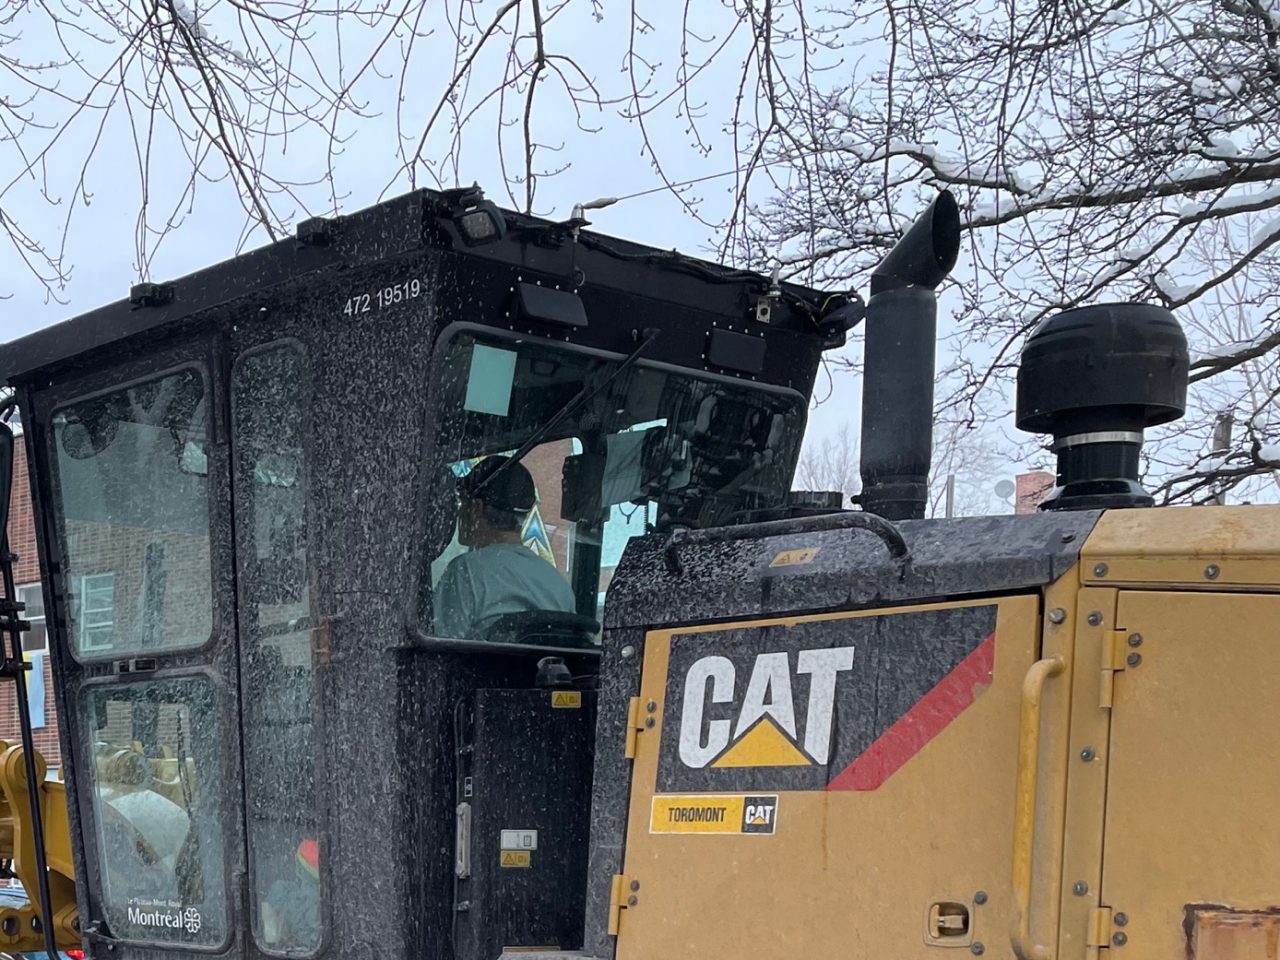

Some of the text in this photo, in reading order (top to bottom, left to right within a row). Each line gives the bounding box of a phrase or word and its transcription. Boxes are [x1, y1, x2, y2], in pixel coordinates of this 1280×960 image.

[343, 279, 420, 316] 472 19519
[679, 646, 855, 768] CAT
[668, 805, 774, 824] TOROMONT CAT
[128, 907, 183, 928] Montréal
